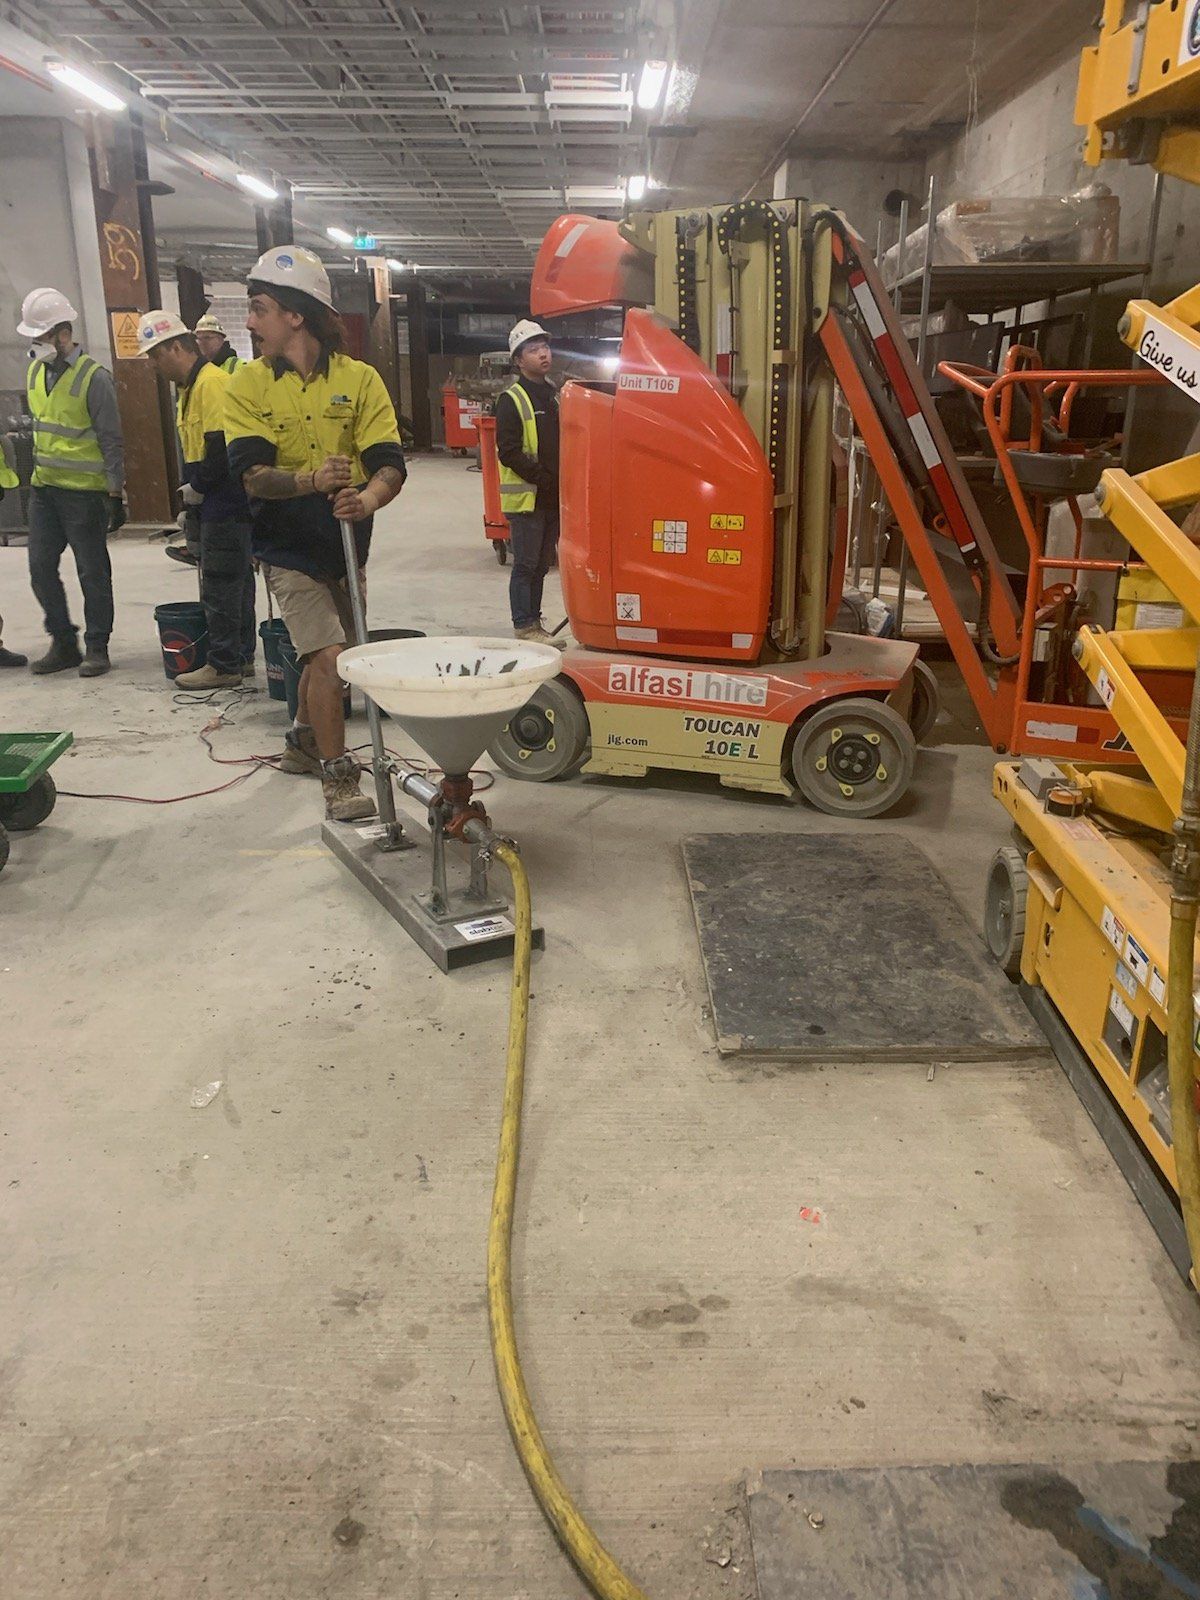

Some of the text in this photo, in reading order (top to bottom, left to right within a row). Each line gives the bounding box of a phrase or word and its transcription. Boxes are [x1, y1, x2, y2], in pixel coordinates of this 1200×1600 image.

[1140, 330, 1198, 389] Give us
[620, 376, 674, 391] Unit T106
[611, 667, 764, 705] alfasi hire
[684, 717, 761, 738] TOUCAN
[607, 733, 648, 747] jlg.com
